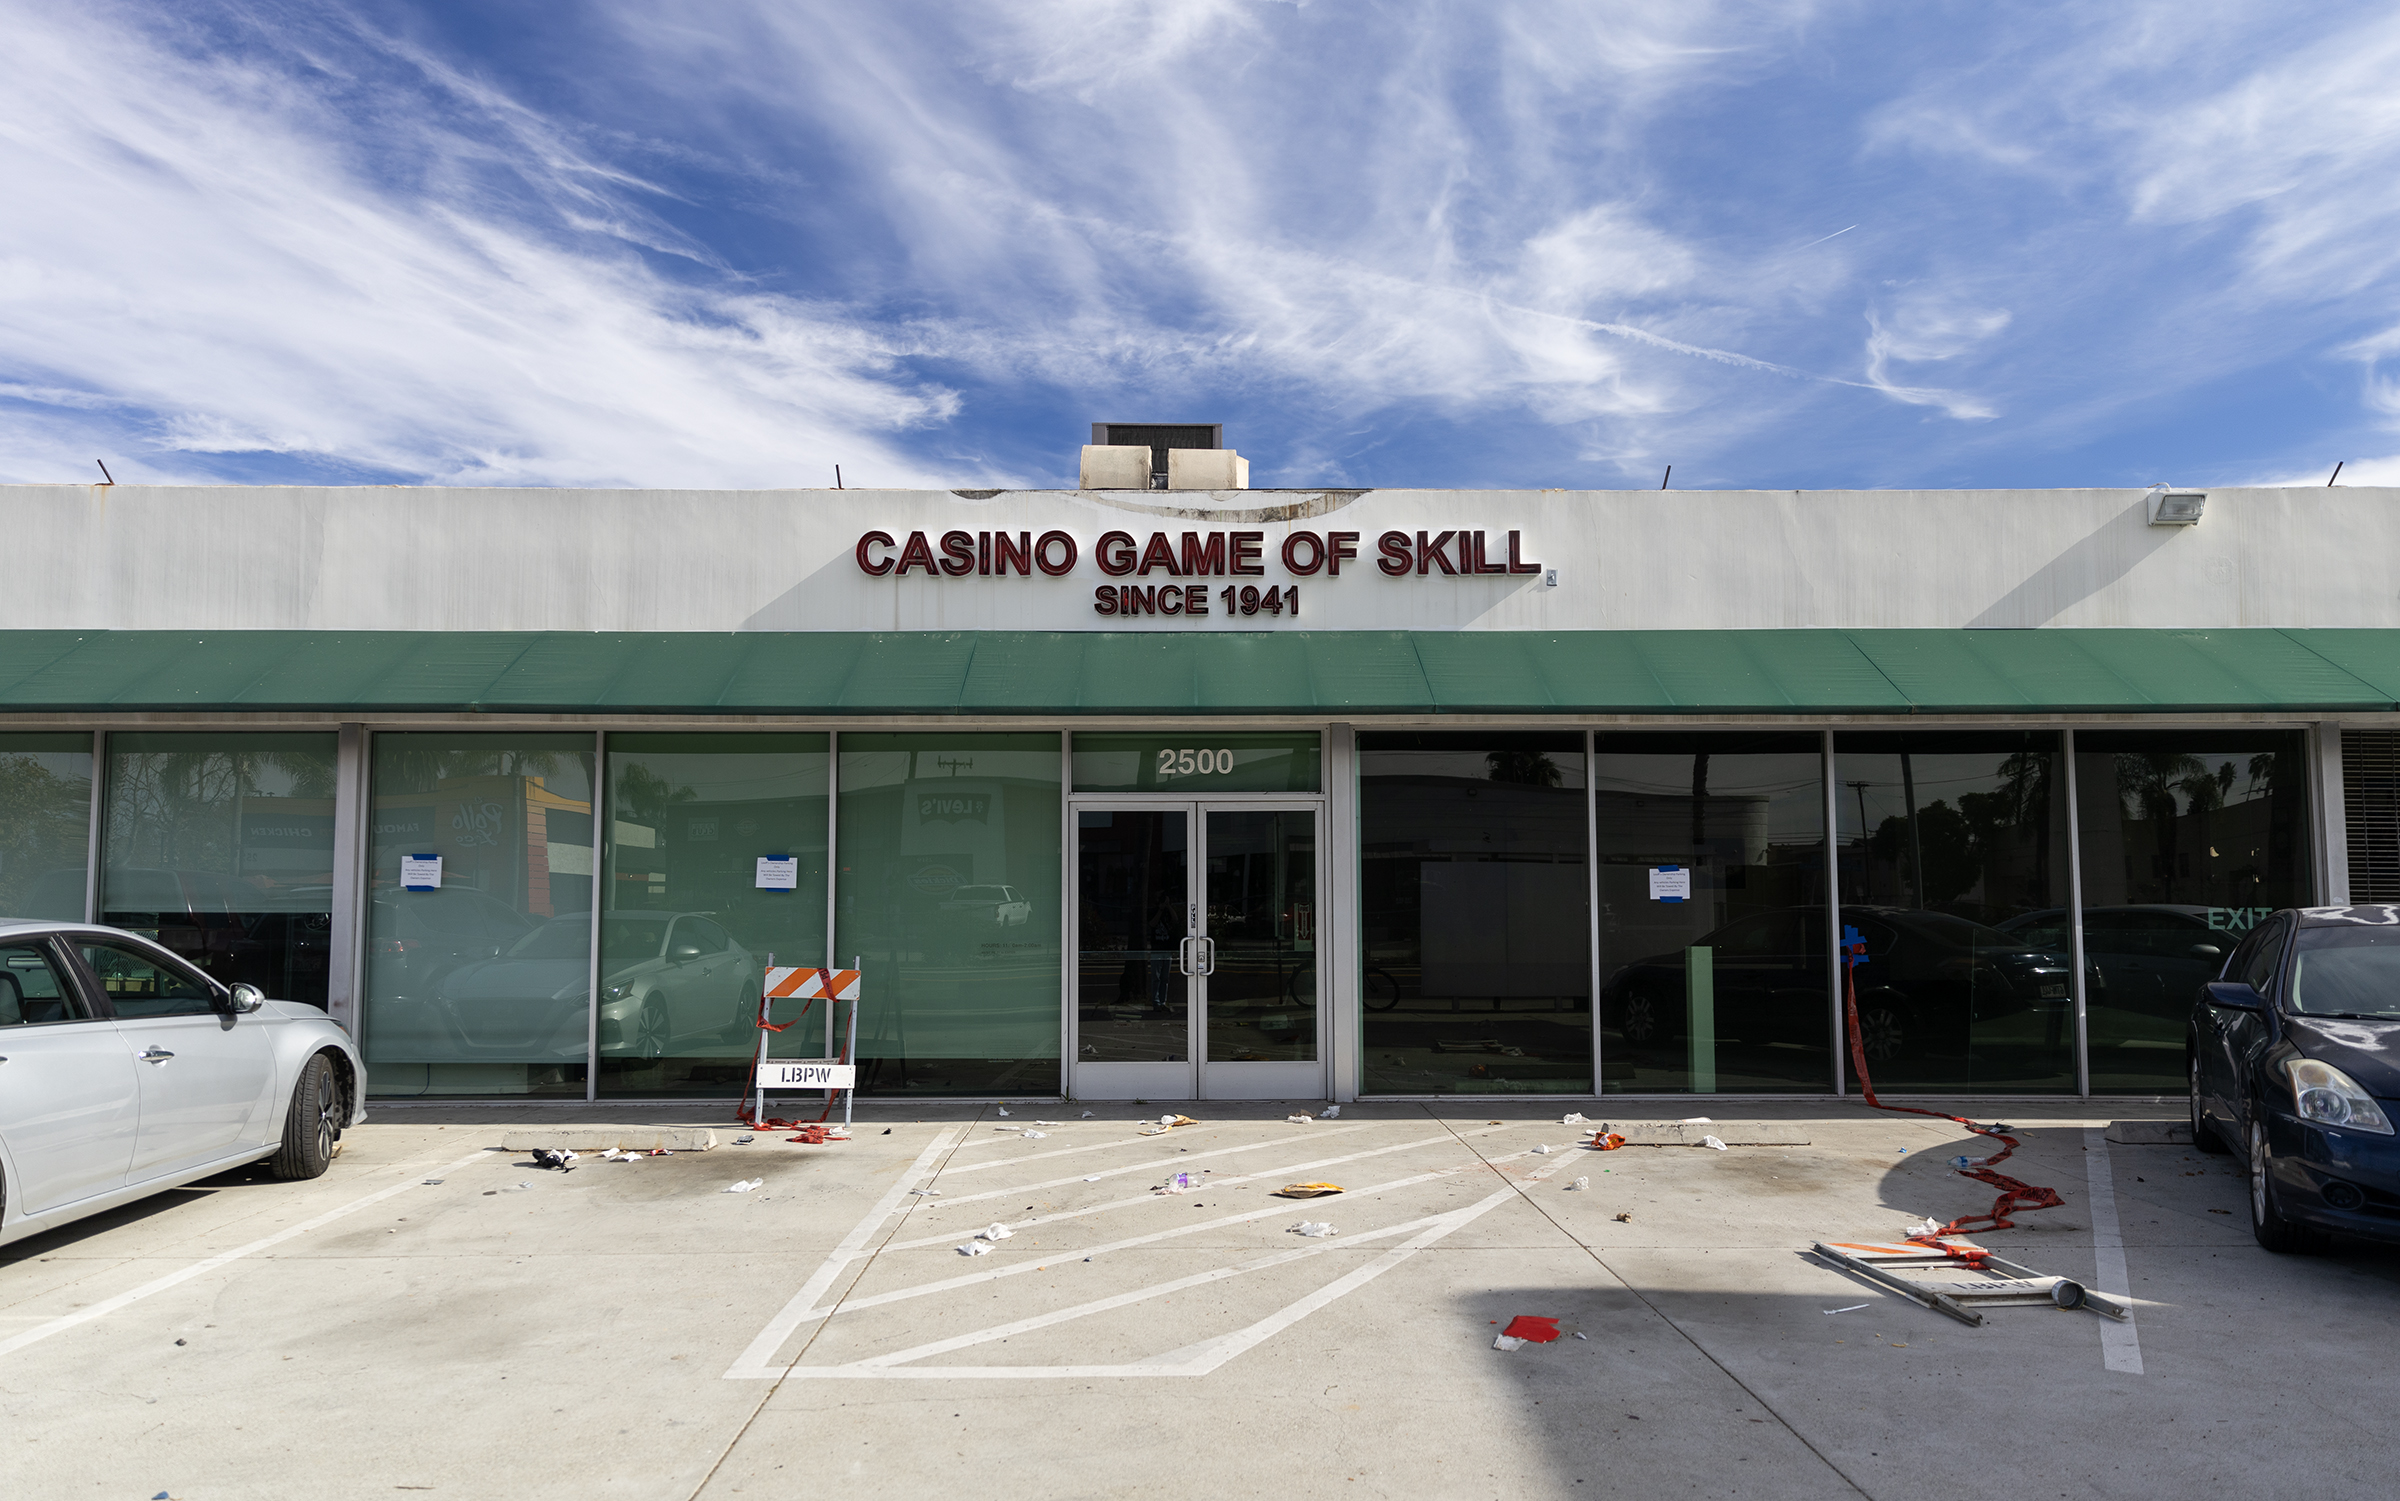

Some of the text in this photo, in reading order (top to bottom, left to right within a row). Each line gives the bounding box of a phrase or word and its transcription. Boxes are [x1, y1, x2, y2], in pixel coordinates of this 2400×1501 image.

[856, 530, 1542, 577] CASINO GAME OF SKILL
[1094, 585, 1299, 616] SINCE 1941
[1159, 748, 1234, 774] 2500
[2208, 907, 2273, 930] EXIT
[781, 1067, 831, 1083] LBPW
